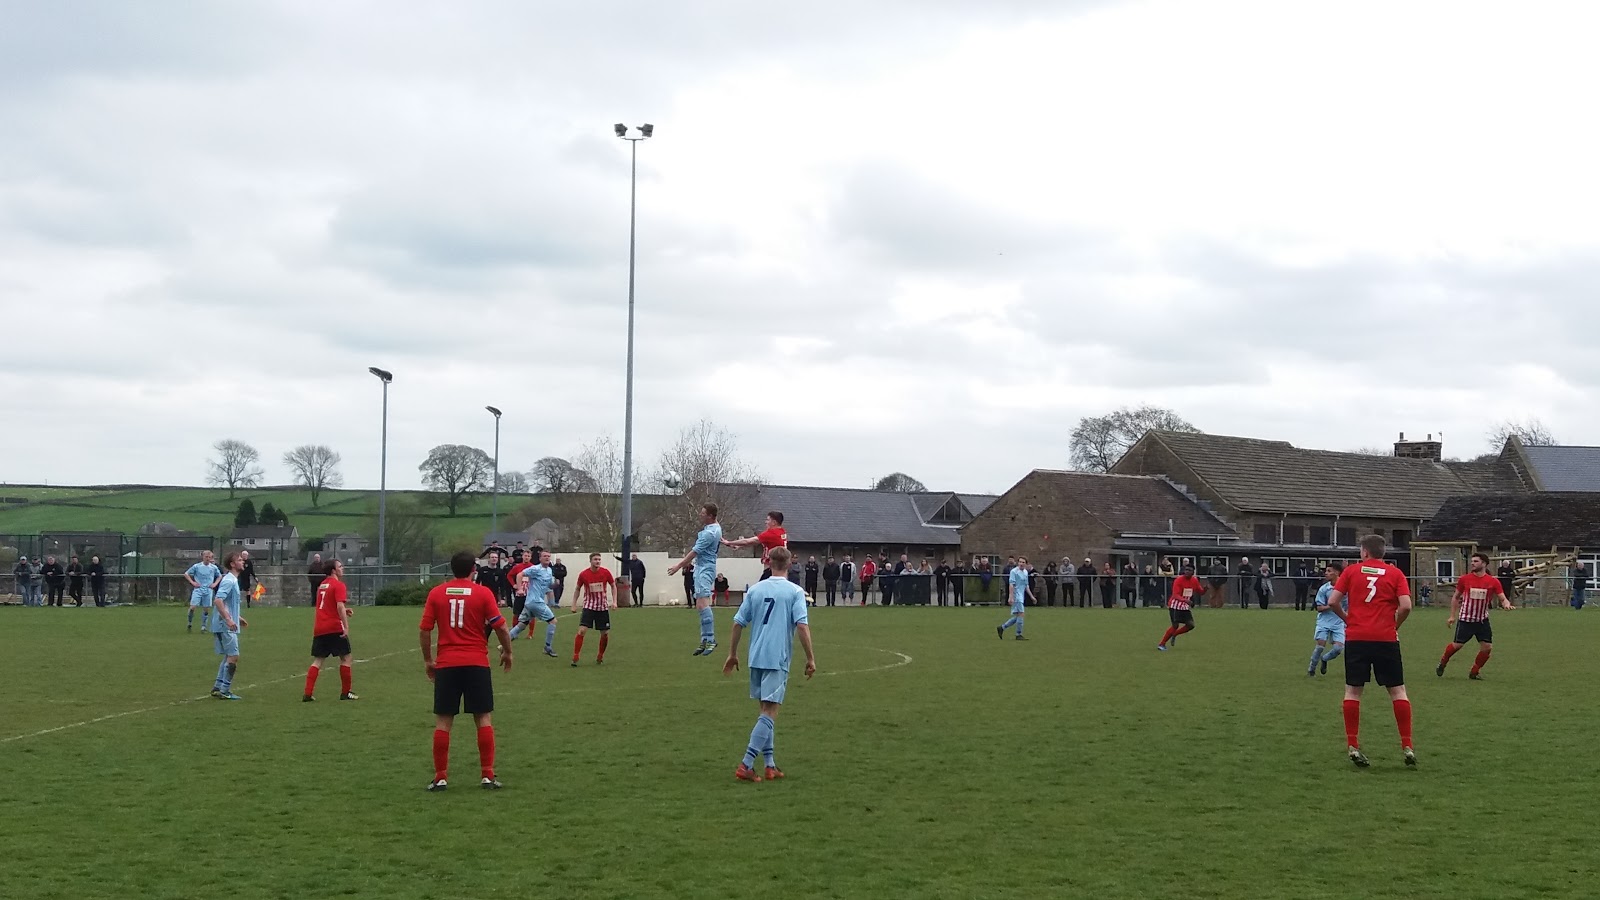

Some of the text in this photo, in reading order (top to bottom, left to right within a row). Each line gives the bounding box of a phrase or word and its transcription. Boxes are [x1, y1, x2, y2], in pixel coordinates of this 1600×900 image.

[319, 591, 326, 610] 7
[1365, 576, 1378, 602] 3
[449, 599, 464, 628] 11
[763, 597, 775, 624] 7
